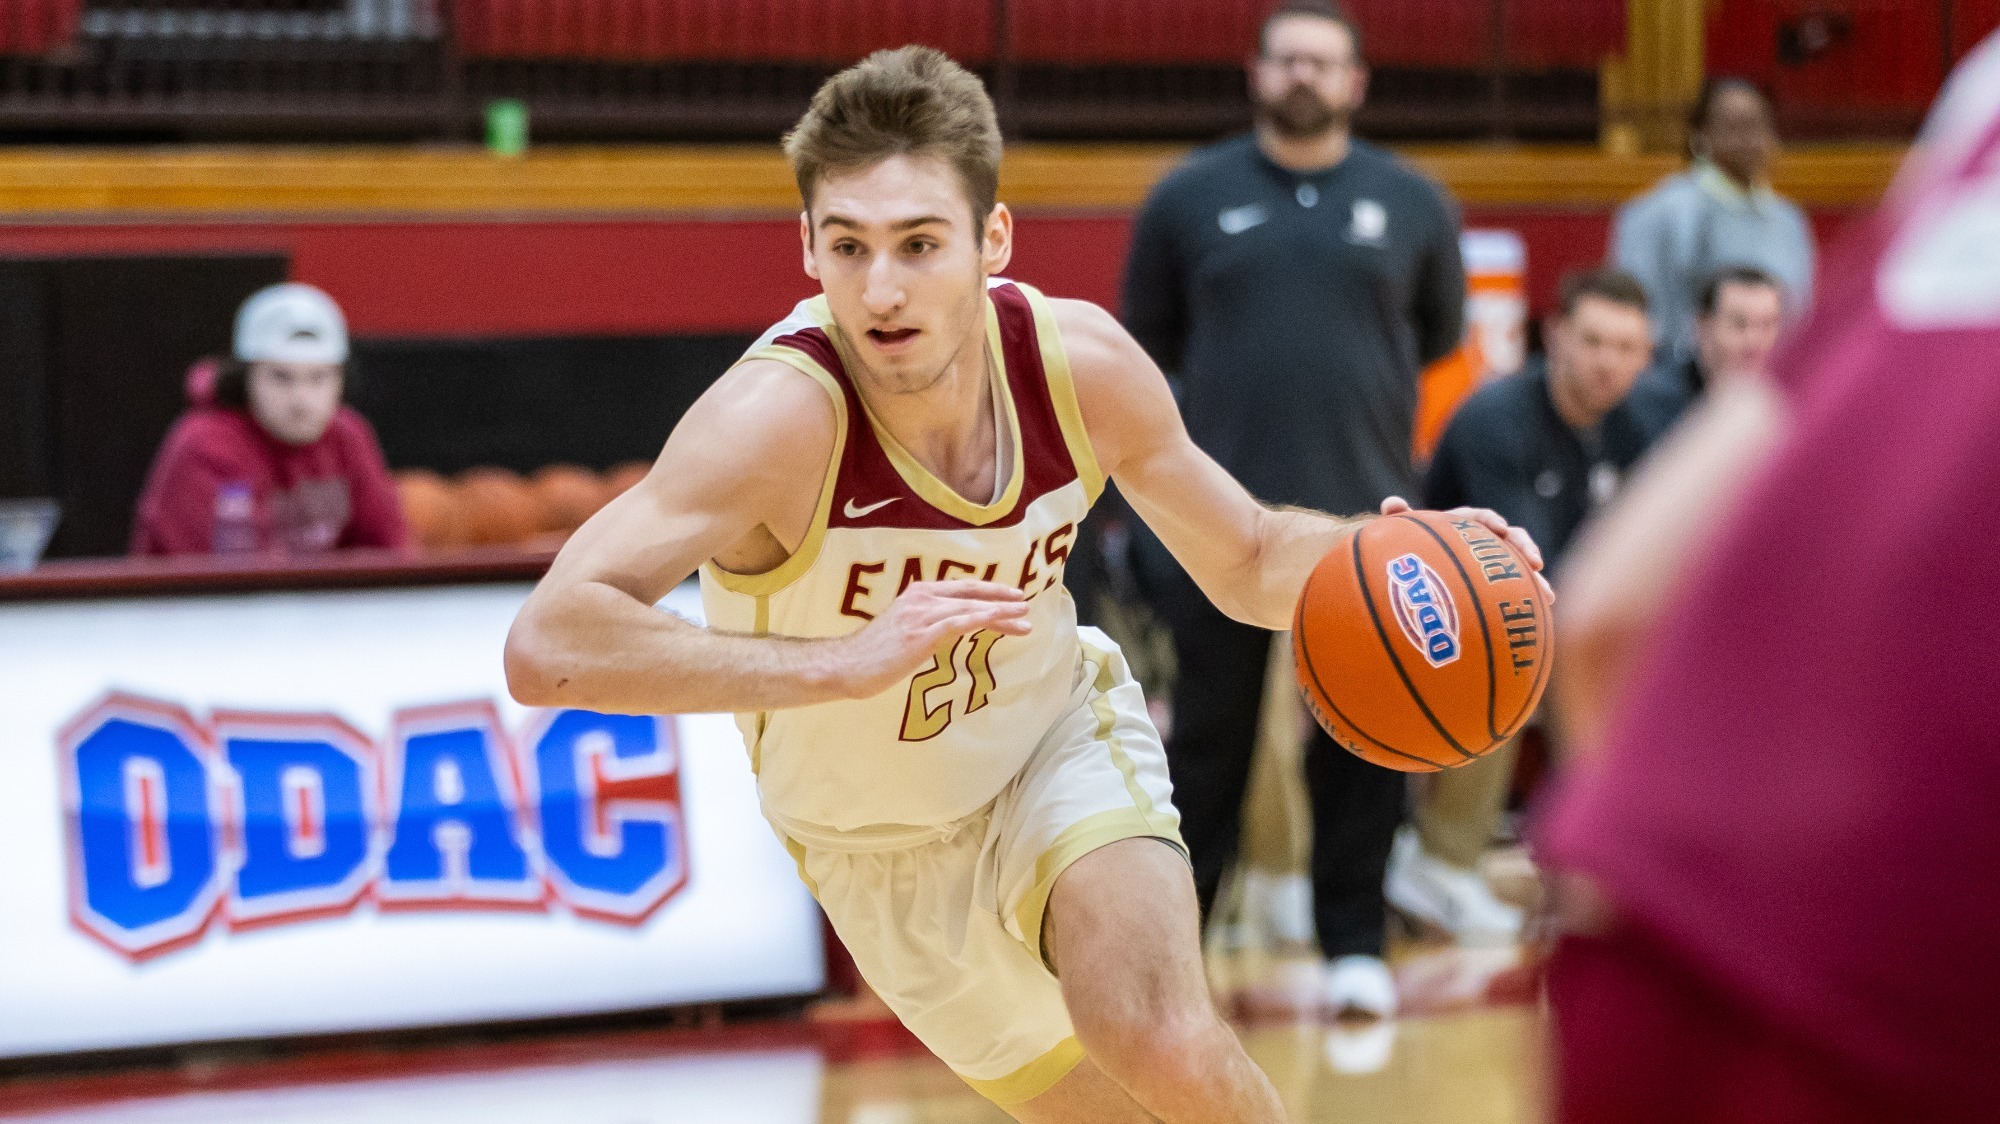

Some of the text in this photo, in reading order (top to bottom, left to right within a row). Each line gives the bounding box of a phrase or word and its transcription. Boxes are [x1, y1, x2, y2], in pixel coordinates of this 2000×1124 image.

[1387, 553, 1461, 668] ODAC
[1449, 519, 1538, 677] THE ROCK
[898, 628, 1006, 741] 21
[57, 690, 690, 963] ODAC
